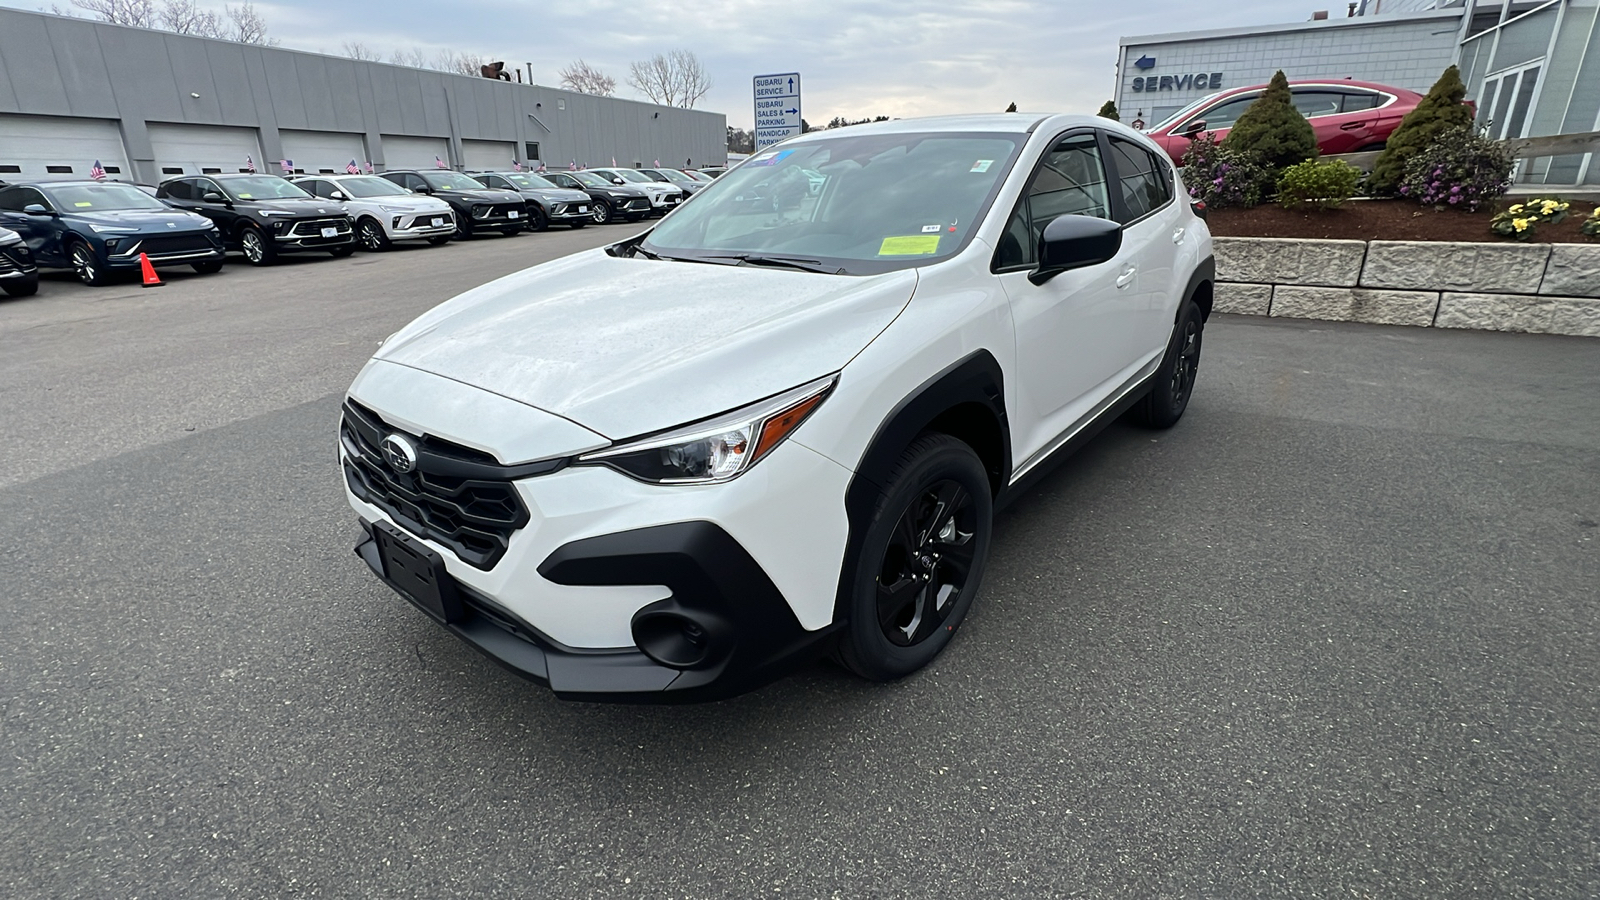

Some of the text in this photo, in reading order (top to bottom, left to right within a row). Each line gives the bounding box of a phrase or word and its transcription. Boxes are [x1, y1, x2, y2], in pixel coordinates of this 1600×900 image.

[756, 78, 783, 87] SUBARU
[1132, 72, 1223, 92] SERVICE
[756, 88, 784, 96] SERVICE
[757, 101, 784, 109] SUBARU
[757, 110, 778, 118] SALES
